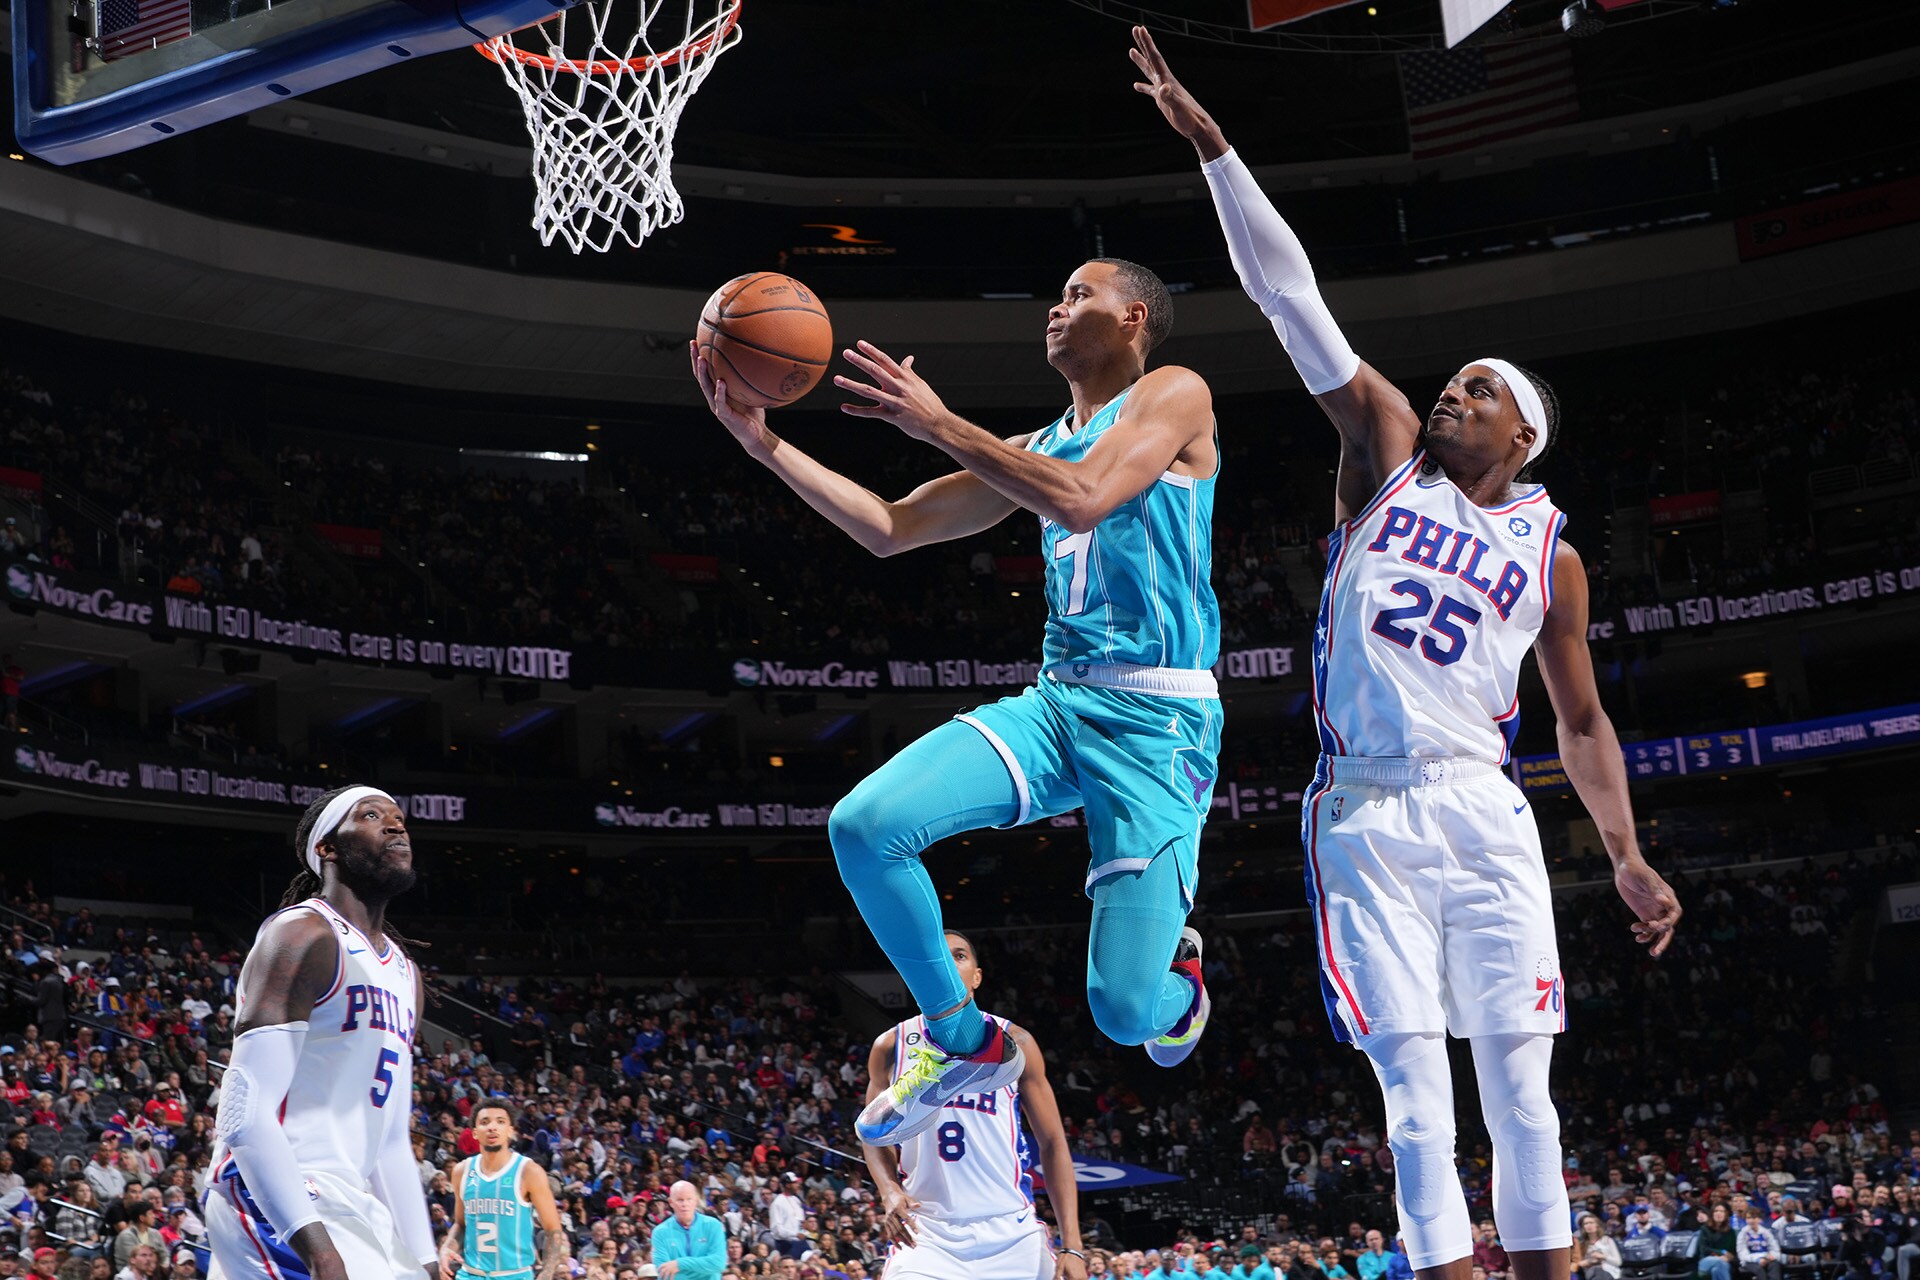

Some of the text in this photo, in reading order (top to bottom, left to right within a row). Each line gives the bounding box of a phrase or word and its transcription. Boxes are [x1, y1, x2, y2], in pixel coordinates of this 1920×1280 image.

[1054, 527, 1096, 617] 7
[1367, 506, 1529, 622] PHILA
[1624, 603, 1676, 634] With
[1677, 596, 1716, 628] 150
[1716, 586, 1824, 621] locations,
[1823, 575, 1874, 605] care
[1874, 568, 1898, 595] is
[31, 570, 154, 625] NovaCare
[163, 594, 213, 634] With
[215, 603, 252, 640] 150
[253, 609, 348, 658] locations,
[348, 631, 393, 661] care
[396, 632, 416, 664] is
[419, 639, 447, 665] on
[449, 642, 505, 676] every
[1370, 578, 1482, 667] 25
[760, 660, 879, 688] NovaCare
[887, 660, 932, 688] With
[934, 659, 971, 688] 150
[1695, 747, 1742, 768] 3 3
[1771, 723, 1868, 753] PHILADELPHIA
[35, 748, 131, 788] NovaCare
[137, 761, 178, 792] With
[180, 766, 210, 796] 150
[615, 804, 711, 828] NovaCare
[717, 803, 757, 828] With
[756, 802, 787, 827] 150
[1534, 975, 1562, 1014] 76
[369, 1046, 400, 1110] 5
[937, 1121, 966, 1163] 8
[464, 1198, 515, 1217] HORNETS
[475, 1221, 499, 1253] 2
